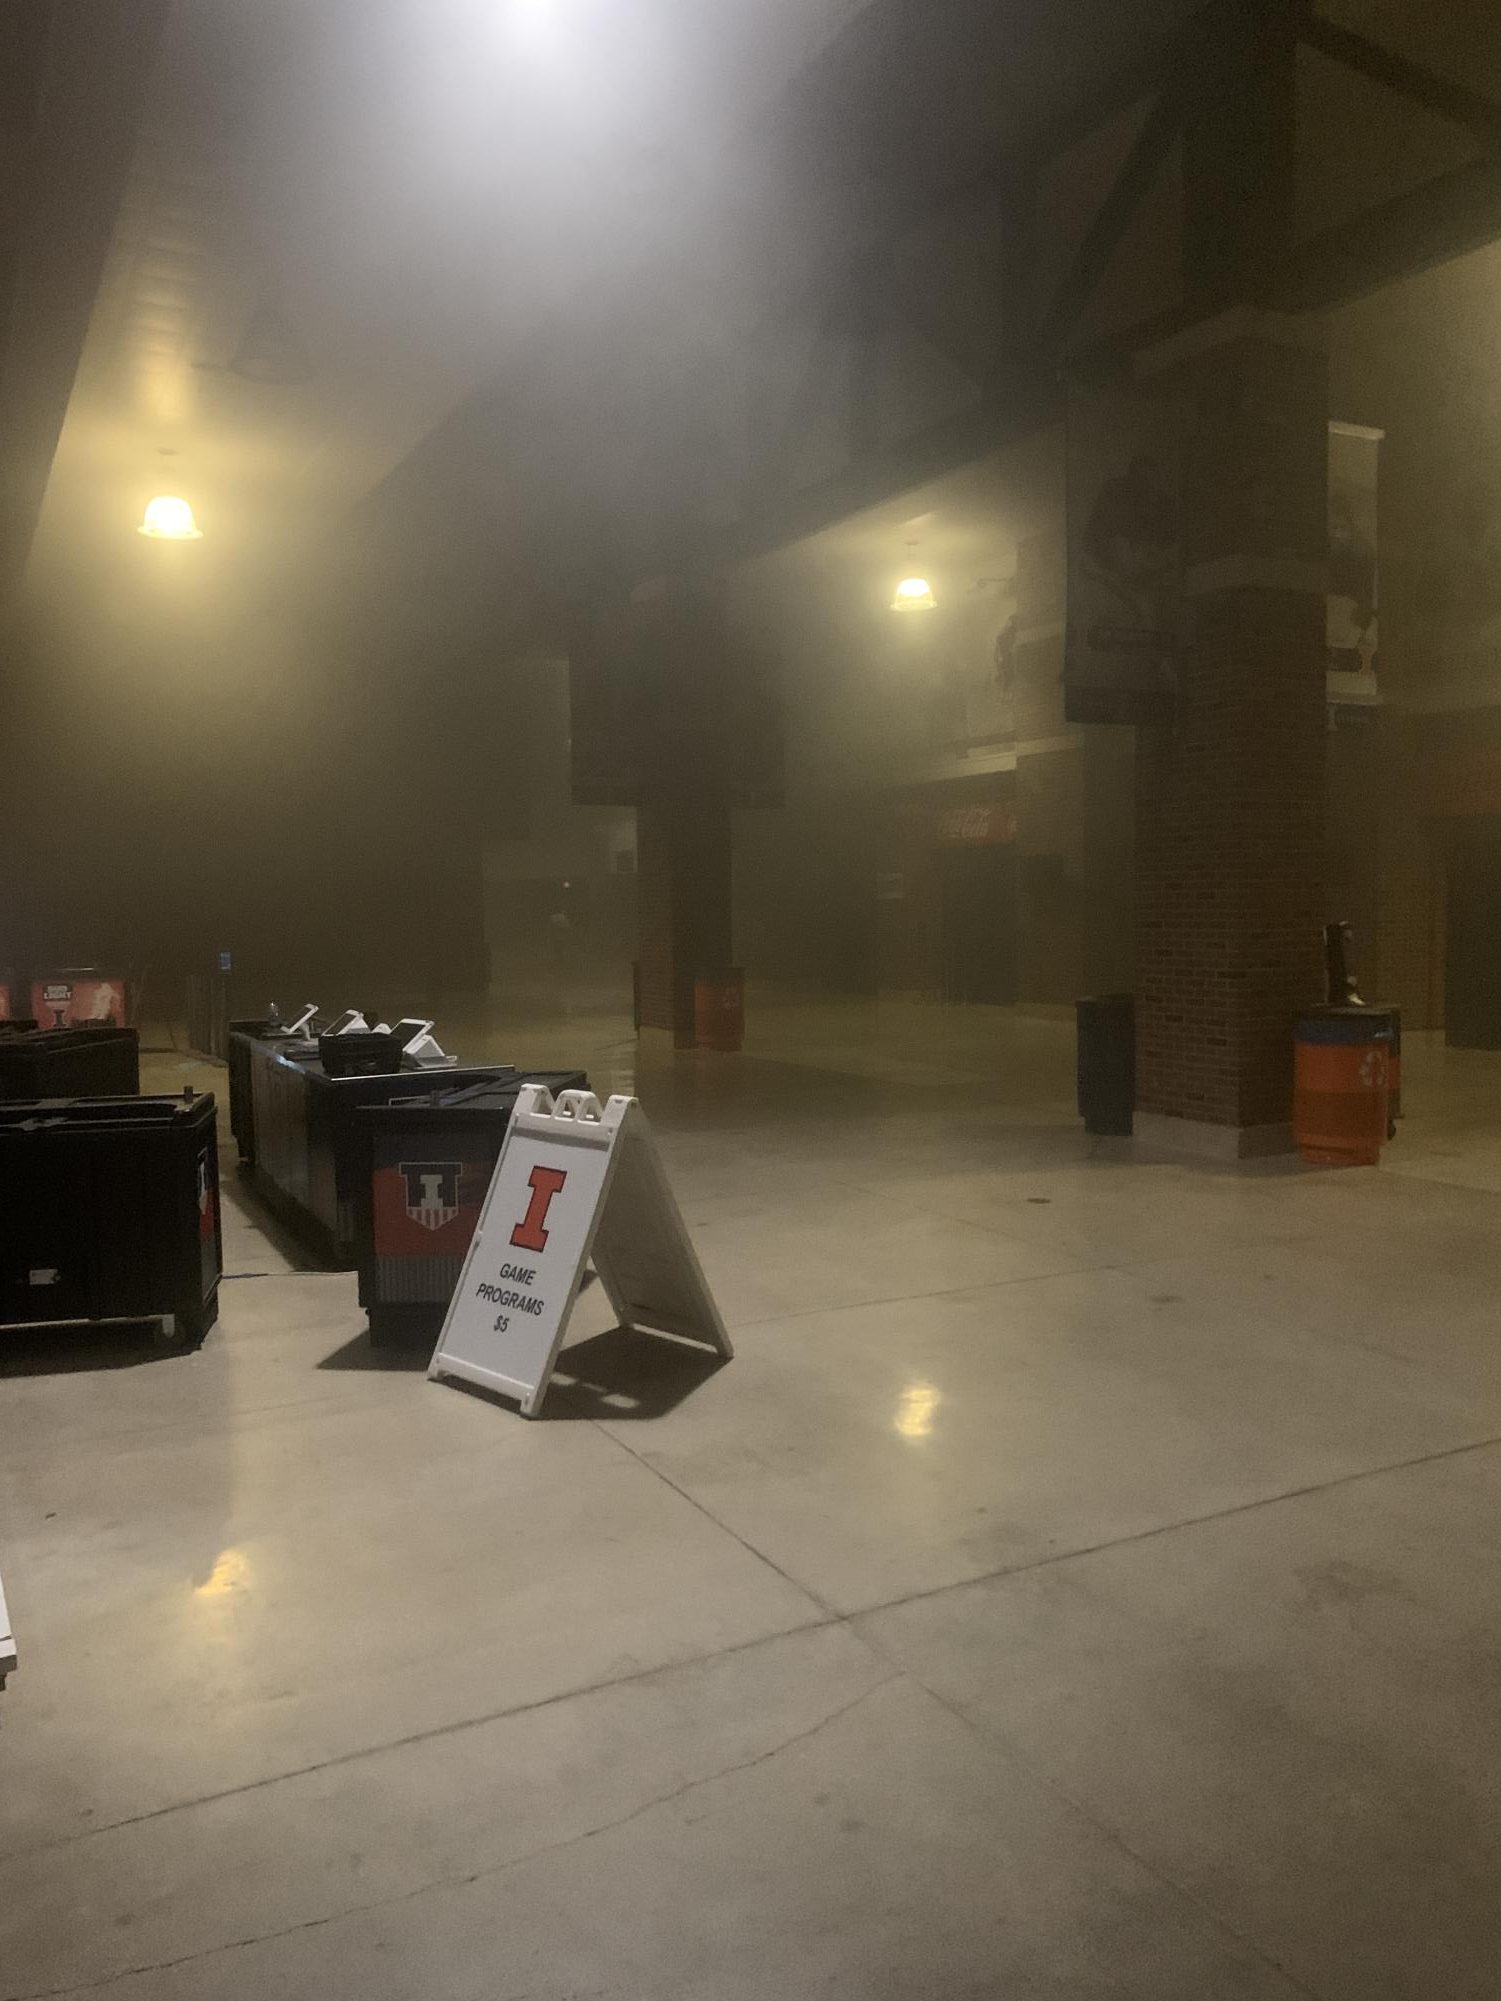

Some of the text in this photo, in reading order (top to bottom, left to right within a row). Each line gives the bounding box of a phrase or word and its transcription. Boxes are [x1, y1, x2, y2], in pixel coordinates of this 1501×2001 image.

[510, 1165, 567, 1253] I
[500, 1263, 536, 1286] GAME
[476, 1283, 545, 1316] PROGRAMS
[493, 1315, 510, 1333] $5
